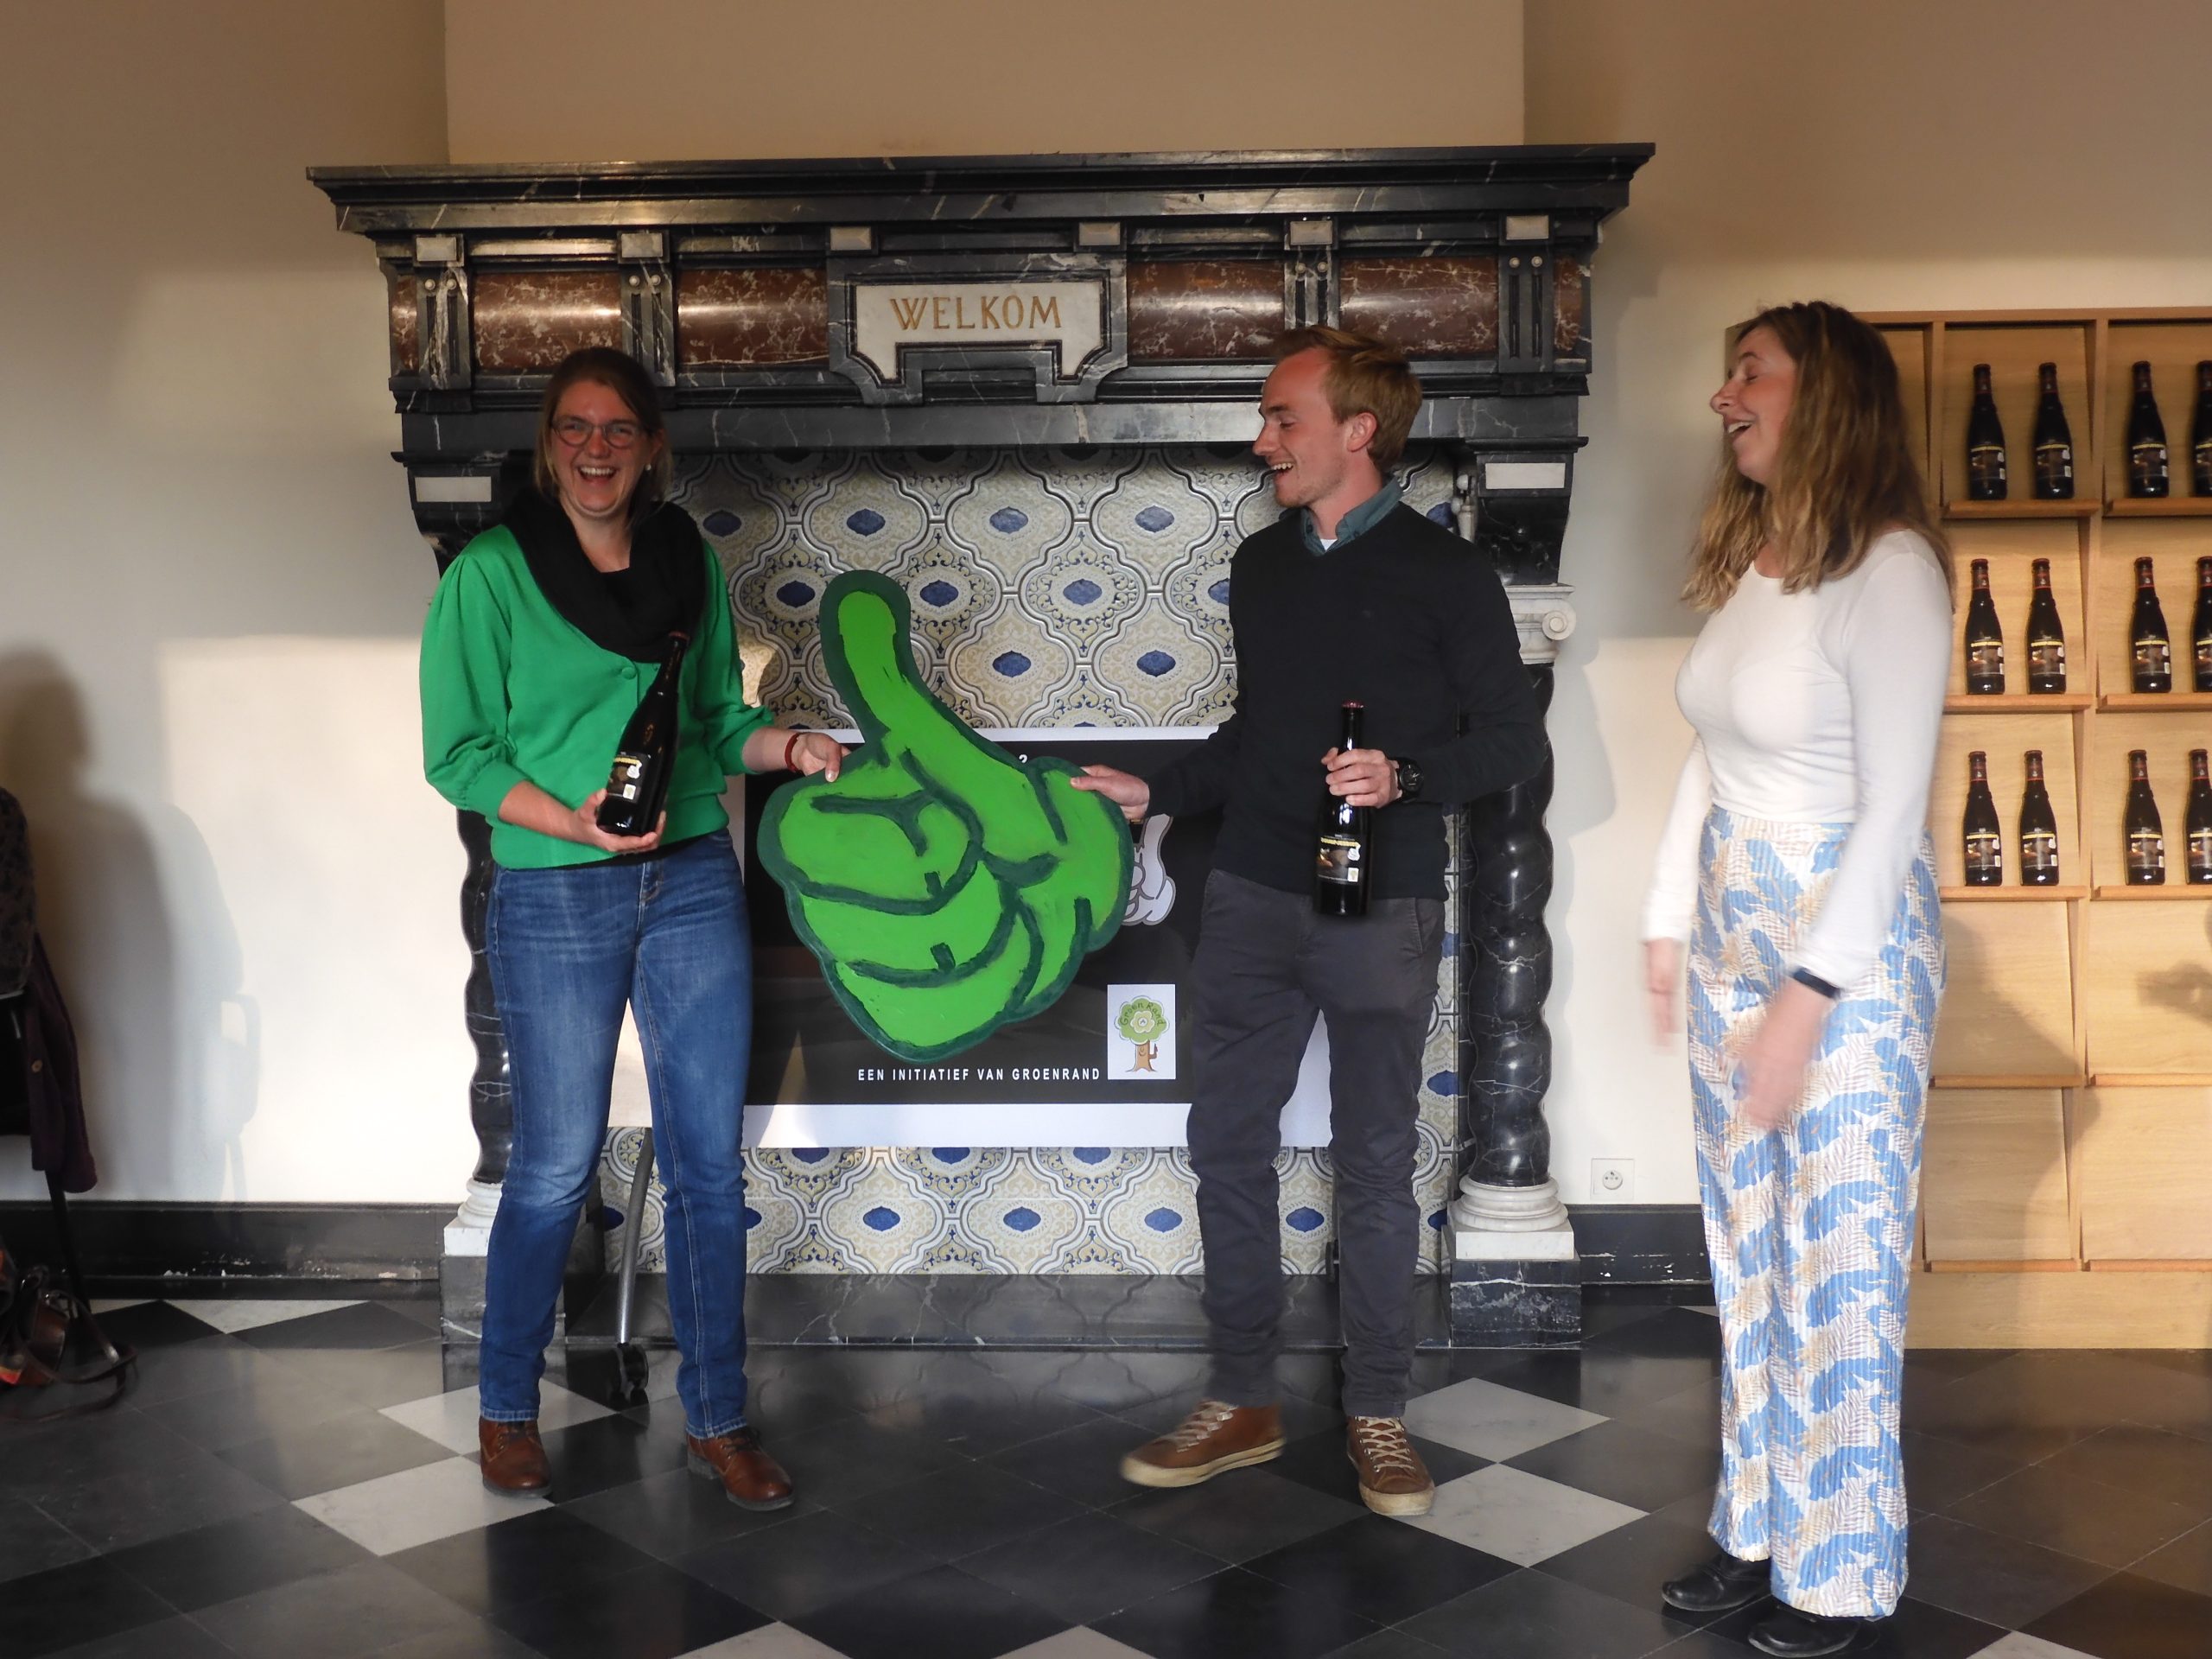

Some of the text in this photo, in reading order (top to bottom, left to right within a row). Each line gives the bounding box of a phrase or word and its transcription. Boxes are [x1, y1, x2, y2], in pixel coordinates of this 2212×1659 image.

[889, 295, 1063, 331] WELKOM
[858, 1068, 1100, 1081] EEN INITIATIEF VAN GROENRAND
